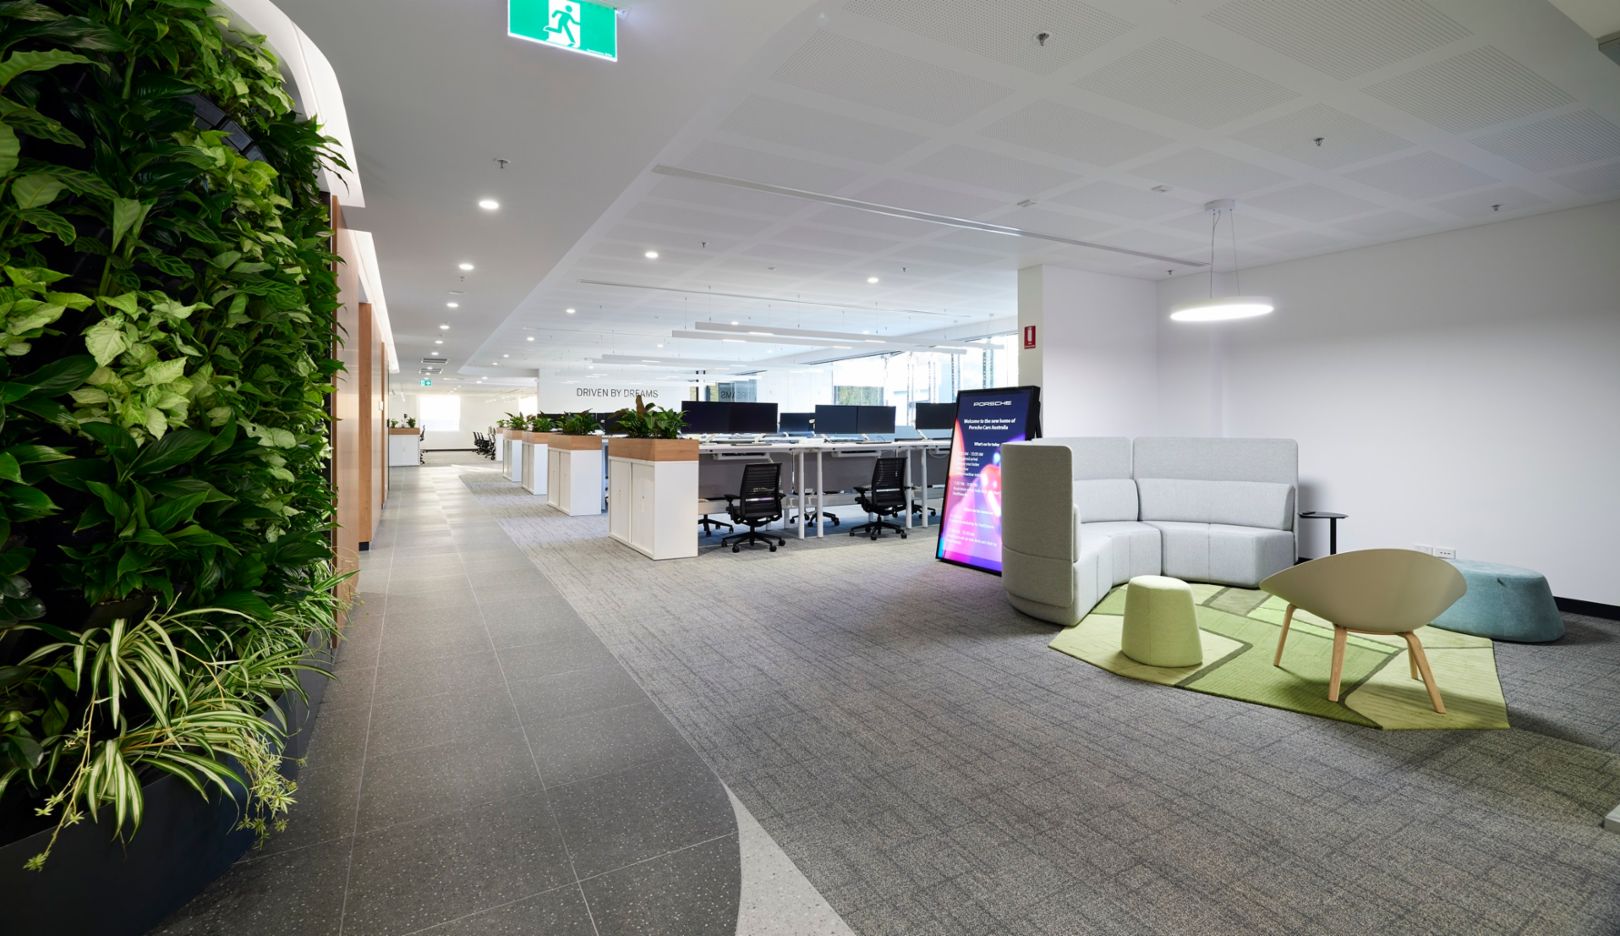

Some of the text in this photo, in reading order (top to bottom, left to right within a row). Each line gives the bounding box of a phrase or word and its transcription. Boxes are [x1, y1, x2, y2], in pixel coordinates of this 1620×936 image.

[576, 387, 659, 398] DRIVEN BY DREAMS
